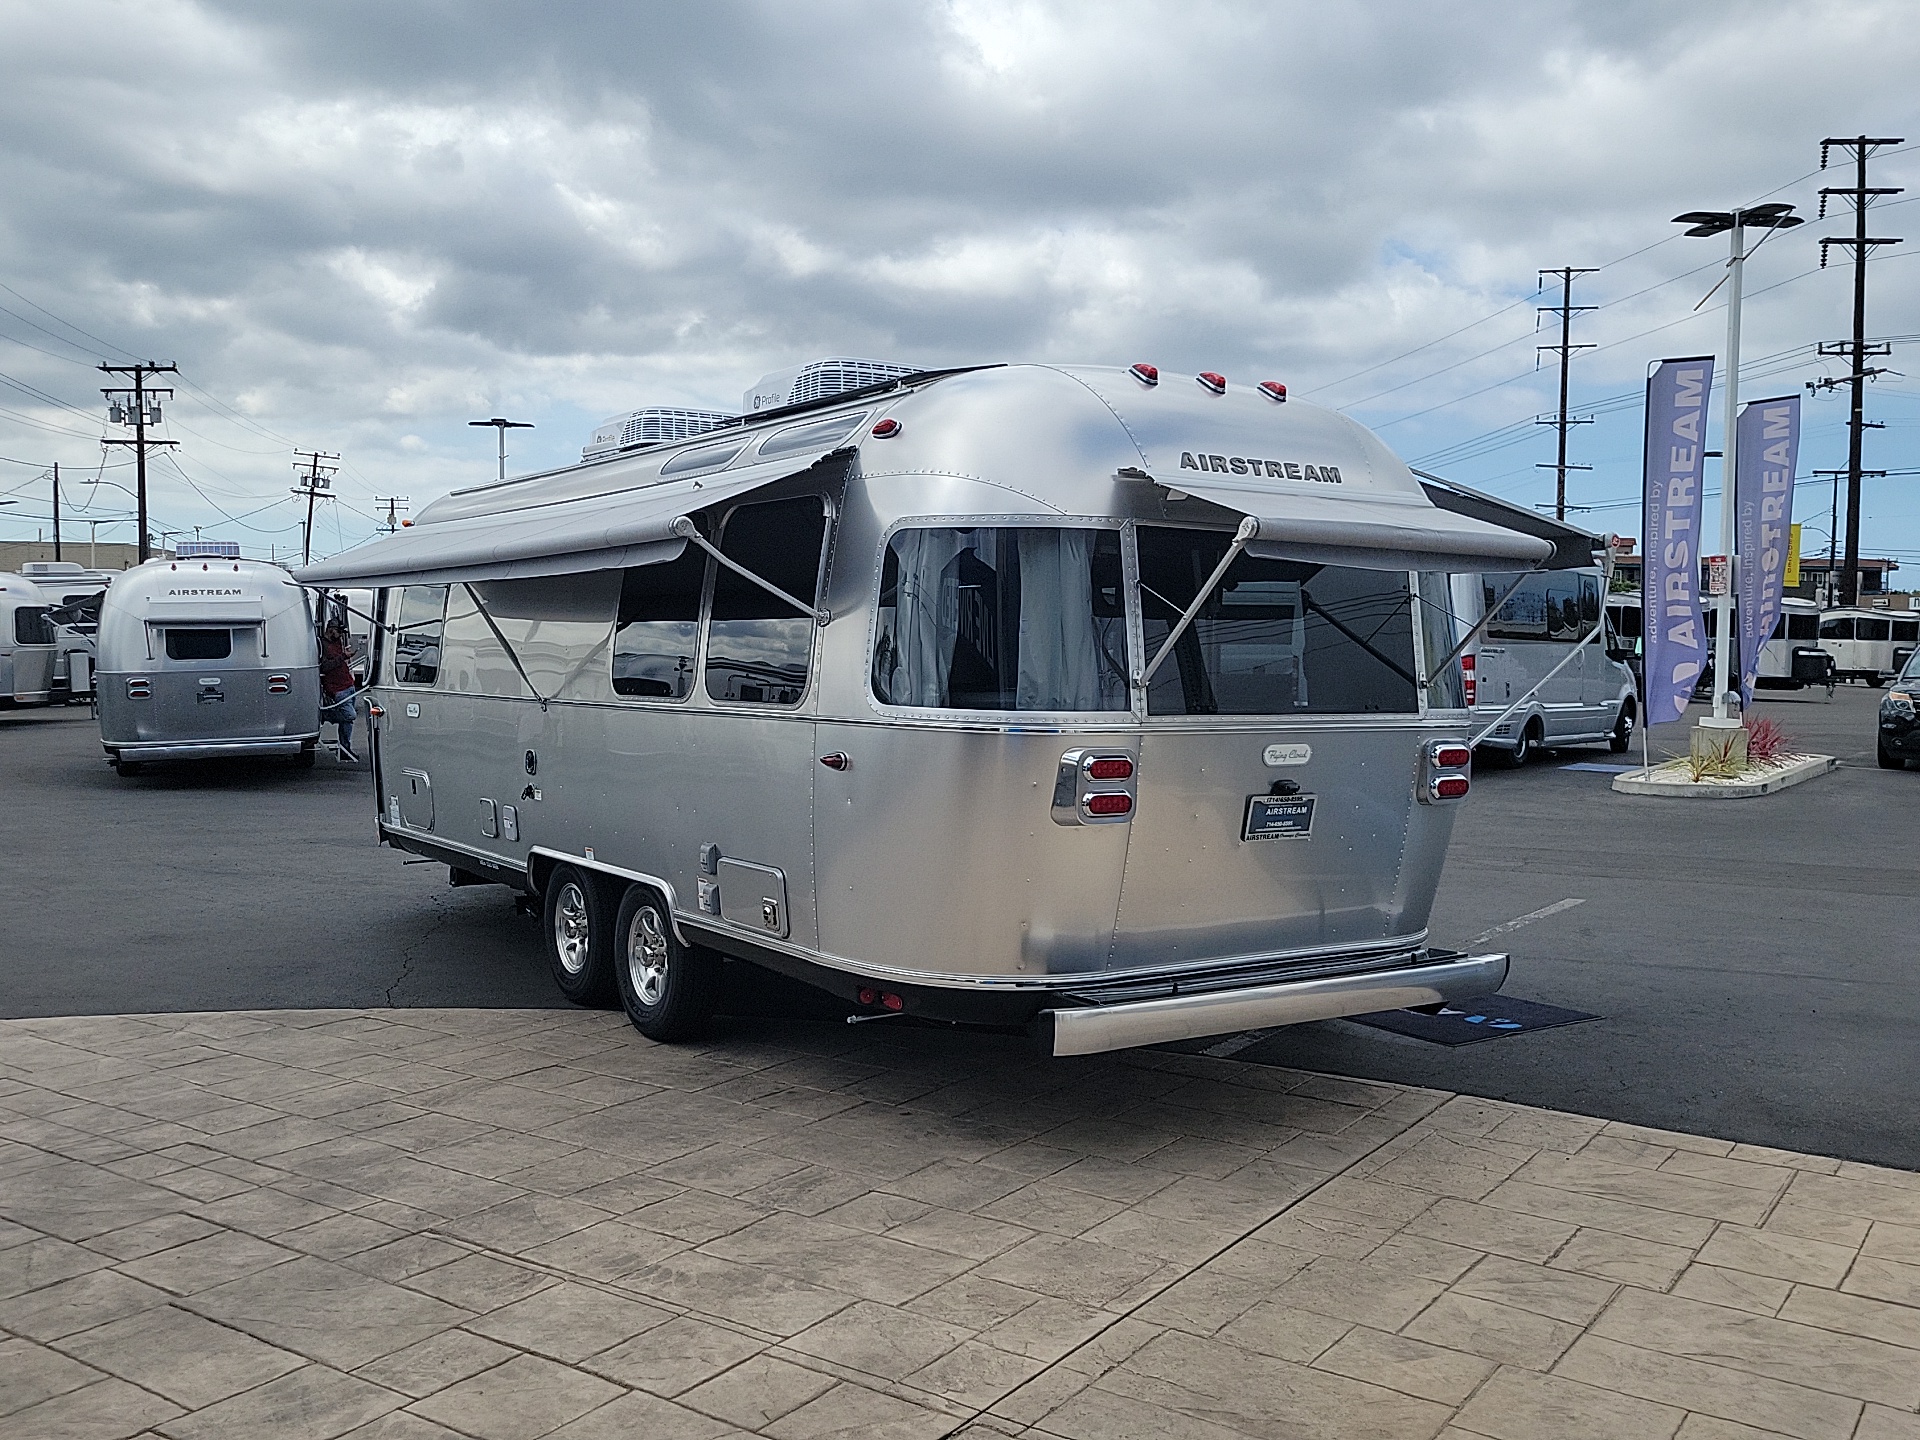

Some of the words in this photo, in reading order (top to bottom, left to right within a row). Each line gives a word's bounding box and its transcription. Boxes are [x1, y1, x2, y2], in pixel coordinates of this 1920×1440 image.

[761, 393, 780, 406] Profile
[1180, 452, 1342, 483] AIRSTREAM
[1650, 480, 1663, 497] by
[1664, 369, 1703, 649] AIRSTREAM
[1742, 500, 1755, 516] by
[1648, 503, 1660, 562] inspired
[1742, 520, 1755, 570] inspired
[1648, 566, 1658, 643] adventure,
[1268, 750, 1287, 762] Flying
[1289, 749, 1308, 758] Cloud
[1266, 807, 1307, 816] AIRSTREAM
